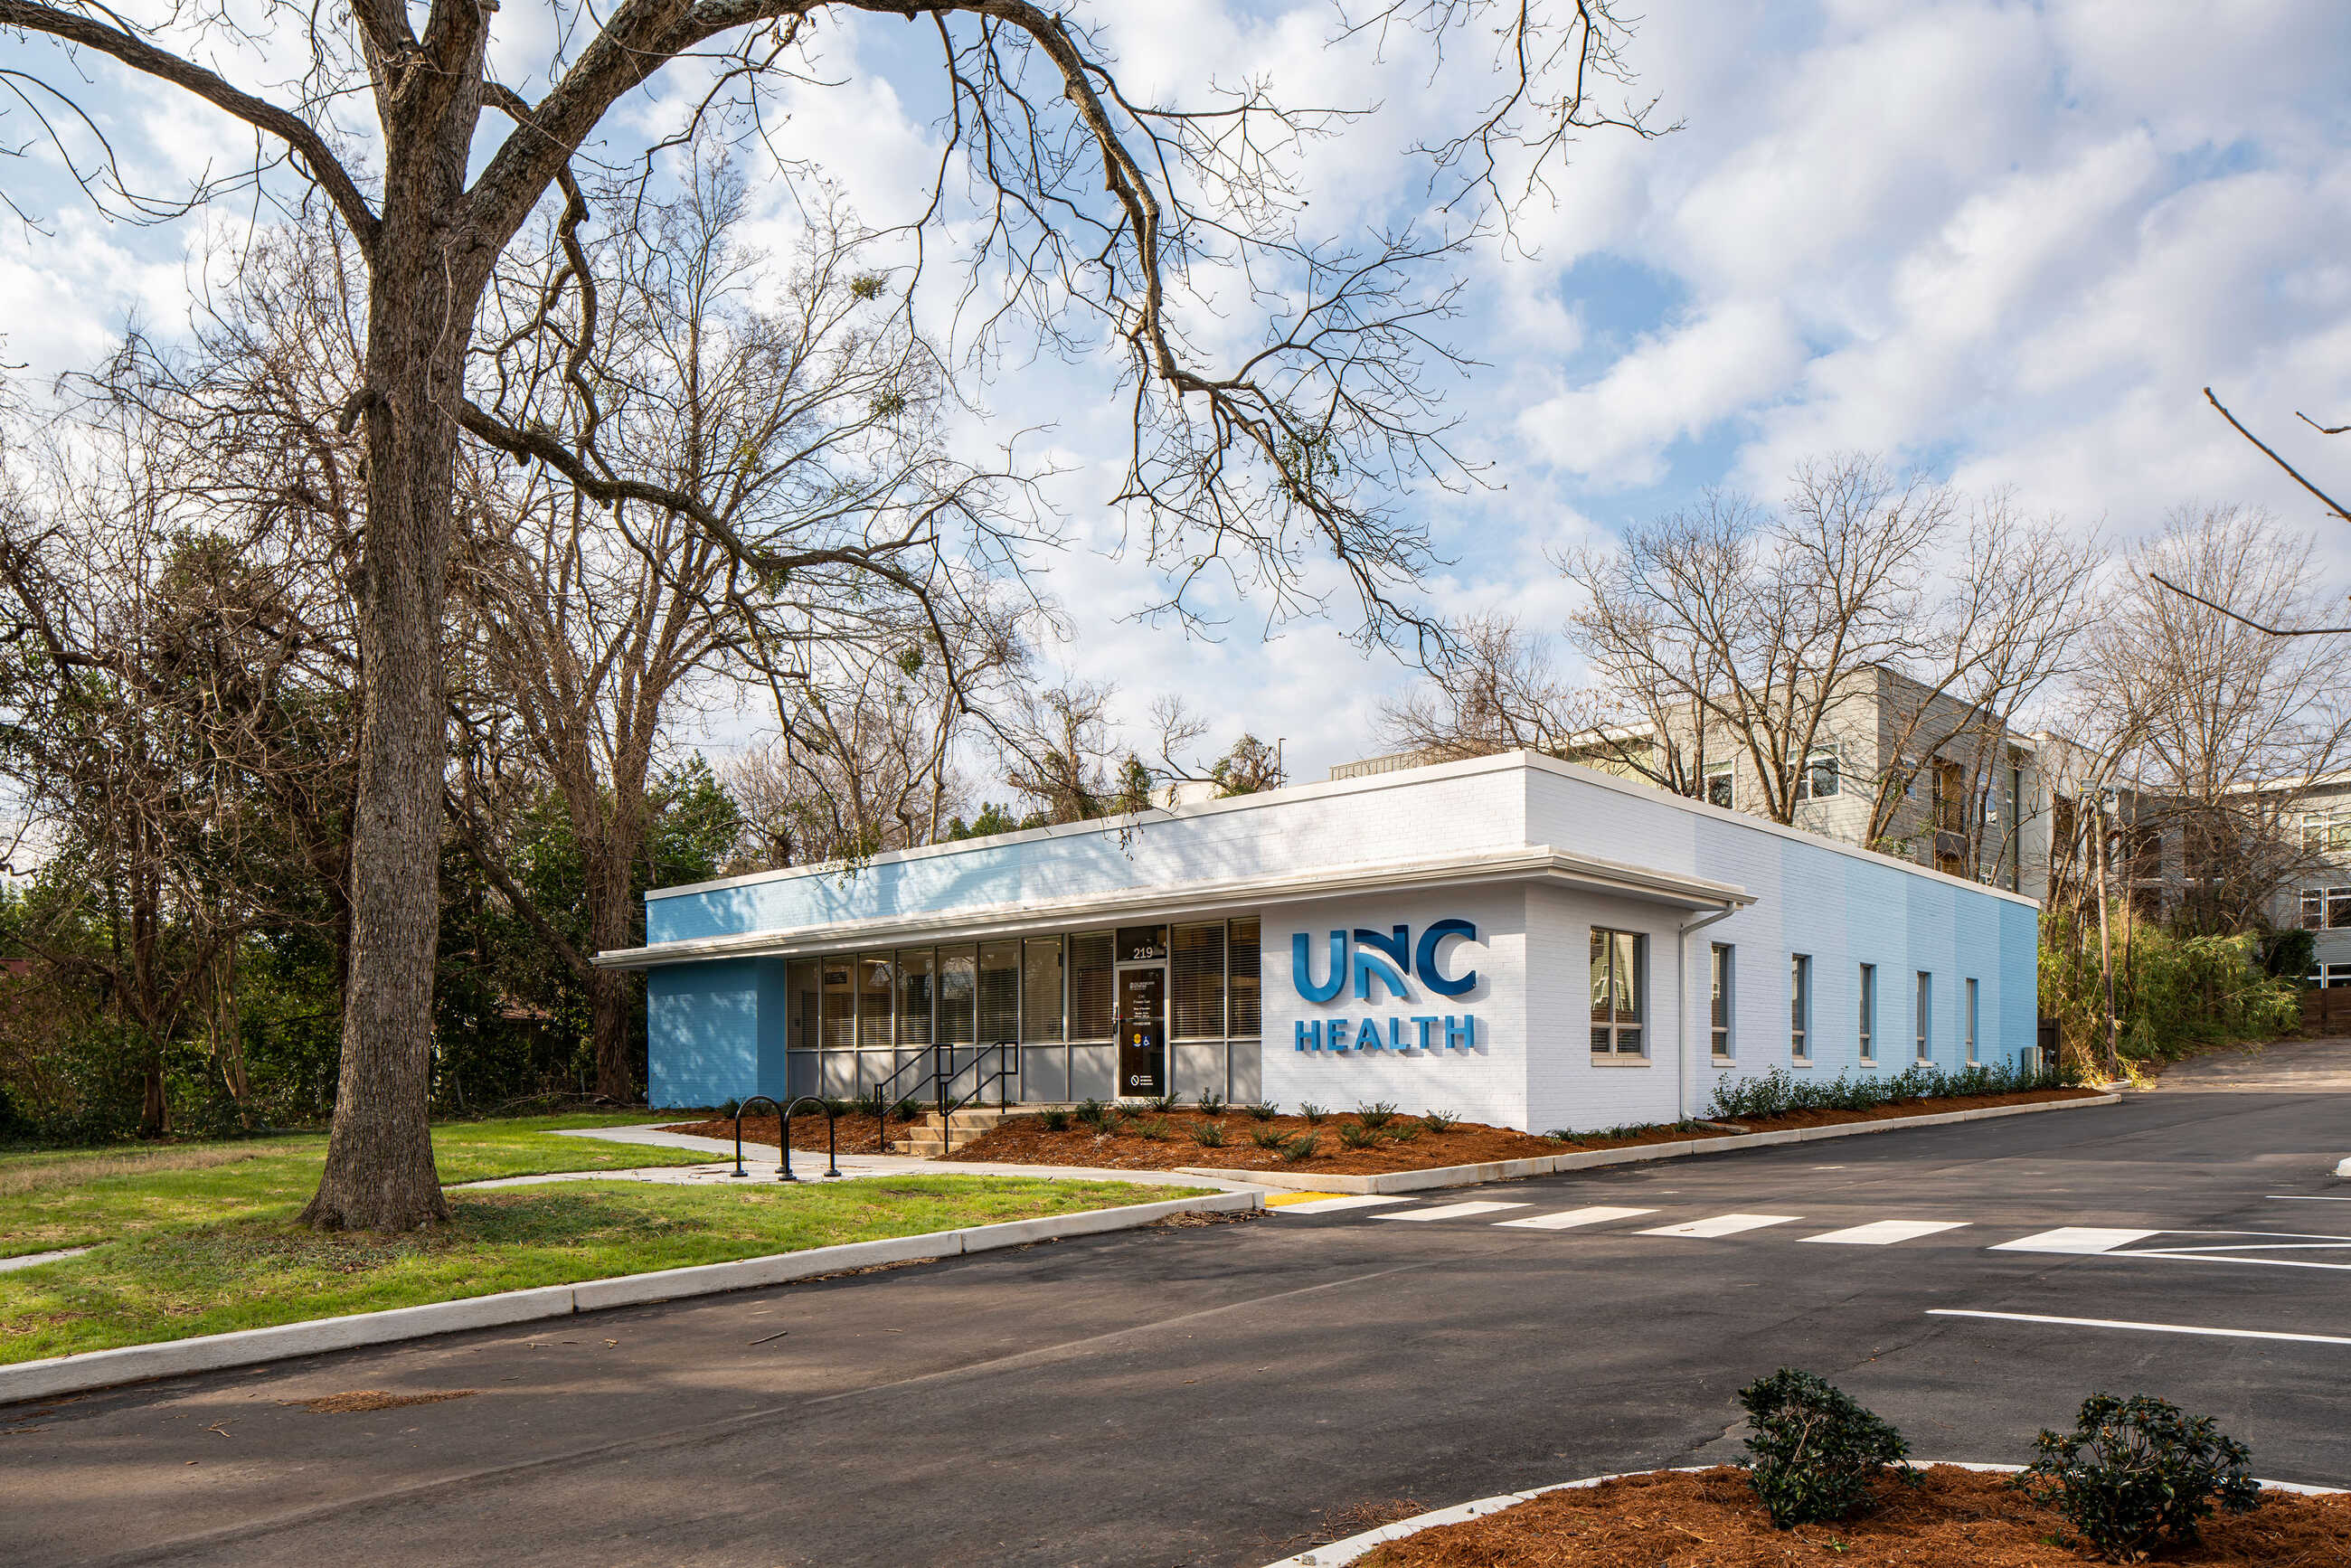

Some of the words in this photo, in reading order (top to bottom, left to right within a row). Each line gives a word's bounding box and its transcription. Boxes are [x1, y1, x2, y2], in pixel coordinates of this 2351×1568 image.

[1134, 947, 1153, 959] 219
[1292, 919, 1477, 1003] UNC
[1295, 1015, 1475, 1052] HEALTH
